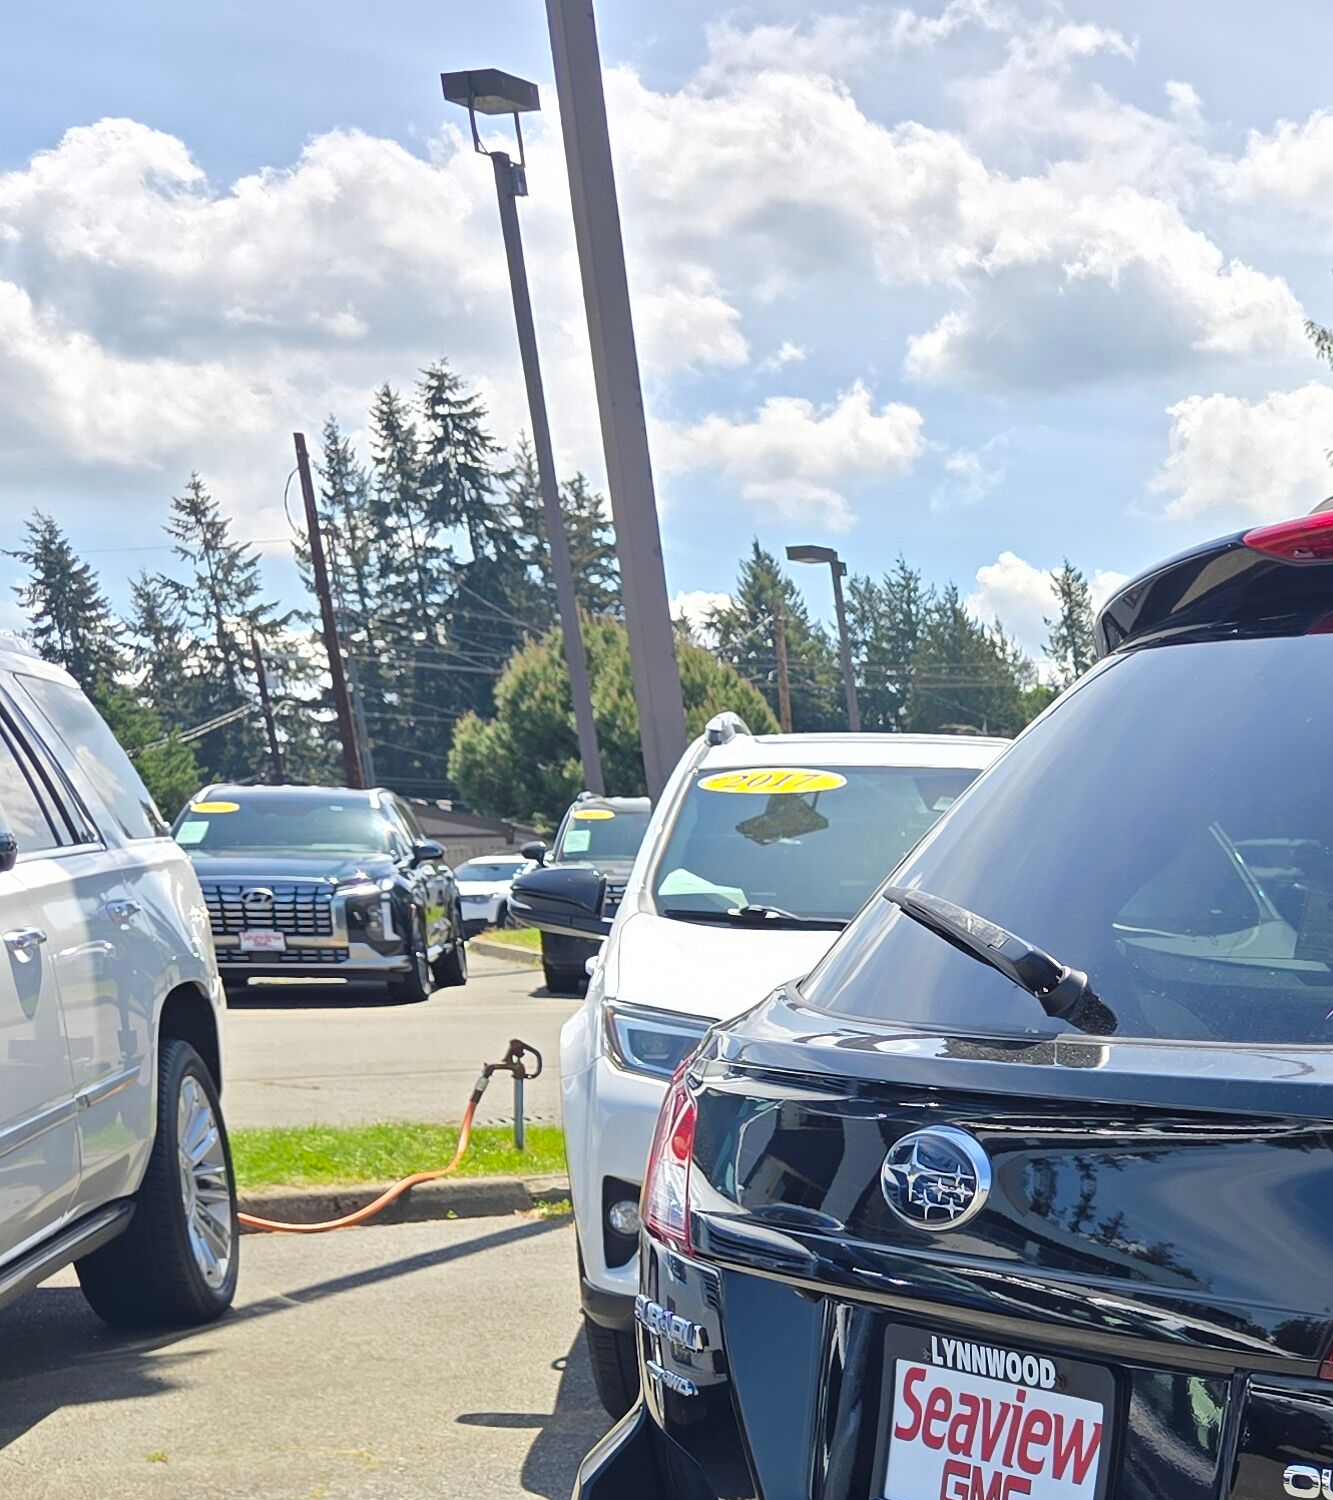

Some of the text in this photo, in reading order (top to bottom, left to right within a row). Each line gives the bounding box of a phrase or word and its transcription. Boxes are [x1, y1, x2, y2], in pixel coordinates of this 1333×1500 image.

[713, 773, 821, 789] 2017
[634, 1294, 709, 1354] SUBARU
[931, 1335, 1056, 1388] LYNNWOOD
[894, 1366, 1103, 1485] Seaview
